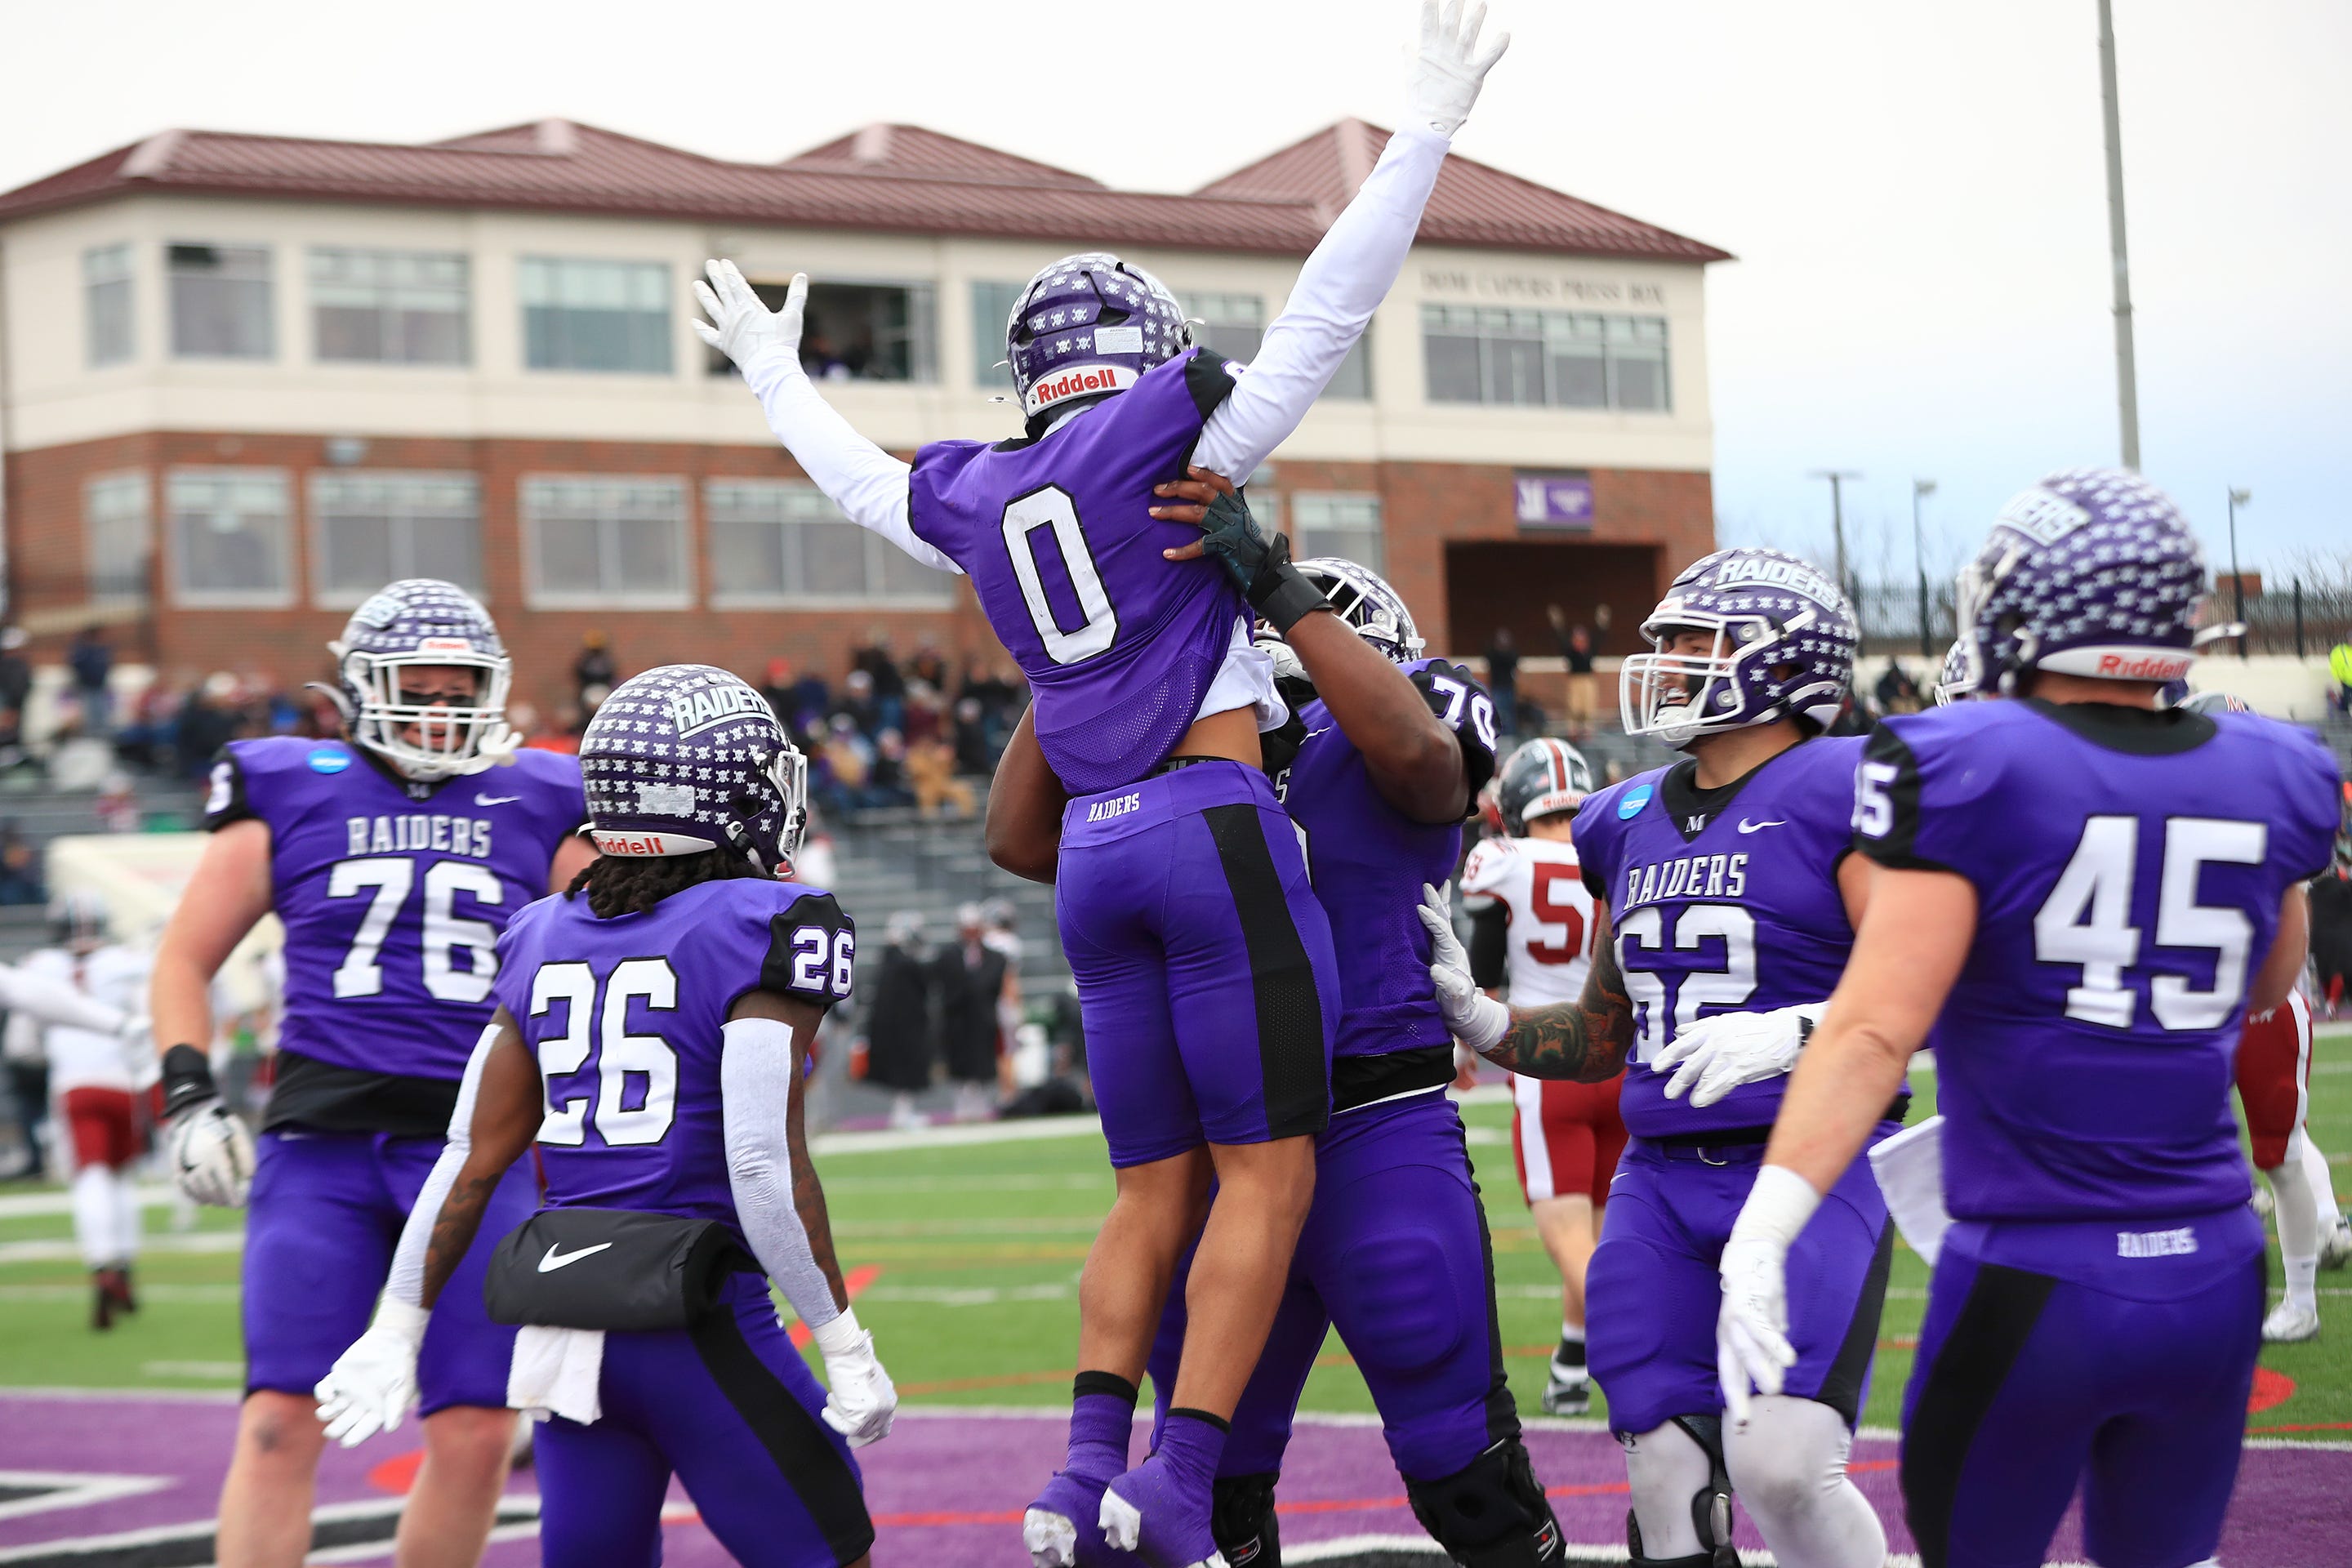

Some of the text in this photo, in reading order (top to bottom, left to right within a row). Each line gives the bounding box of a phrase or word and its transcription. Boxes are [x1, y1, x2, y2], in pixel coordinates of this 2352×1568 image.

[1036, 368, 1117, 404] Riddell
[1000, 483, 1120, 665] 0
[1715, 559, 1840, 609] RAIDERS
[1431, 674, 1497, 752] 70
[346, 814, 492, 858] RAIDERS
[1086, 792, 1141, 823] RAIDERS
[1685, 813, 1707, 832] M
[1623, 853, 1749, 911] RAIDERS
[327, 857, 504, 1003] 76
[2034, 815, 2267, 1031] 45
[786, 924, 856, 998] 26
[1614, 903, 1757, 1063] 62
[529, 956, 679, 1147] 26
